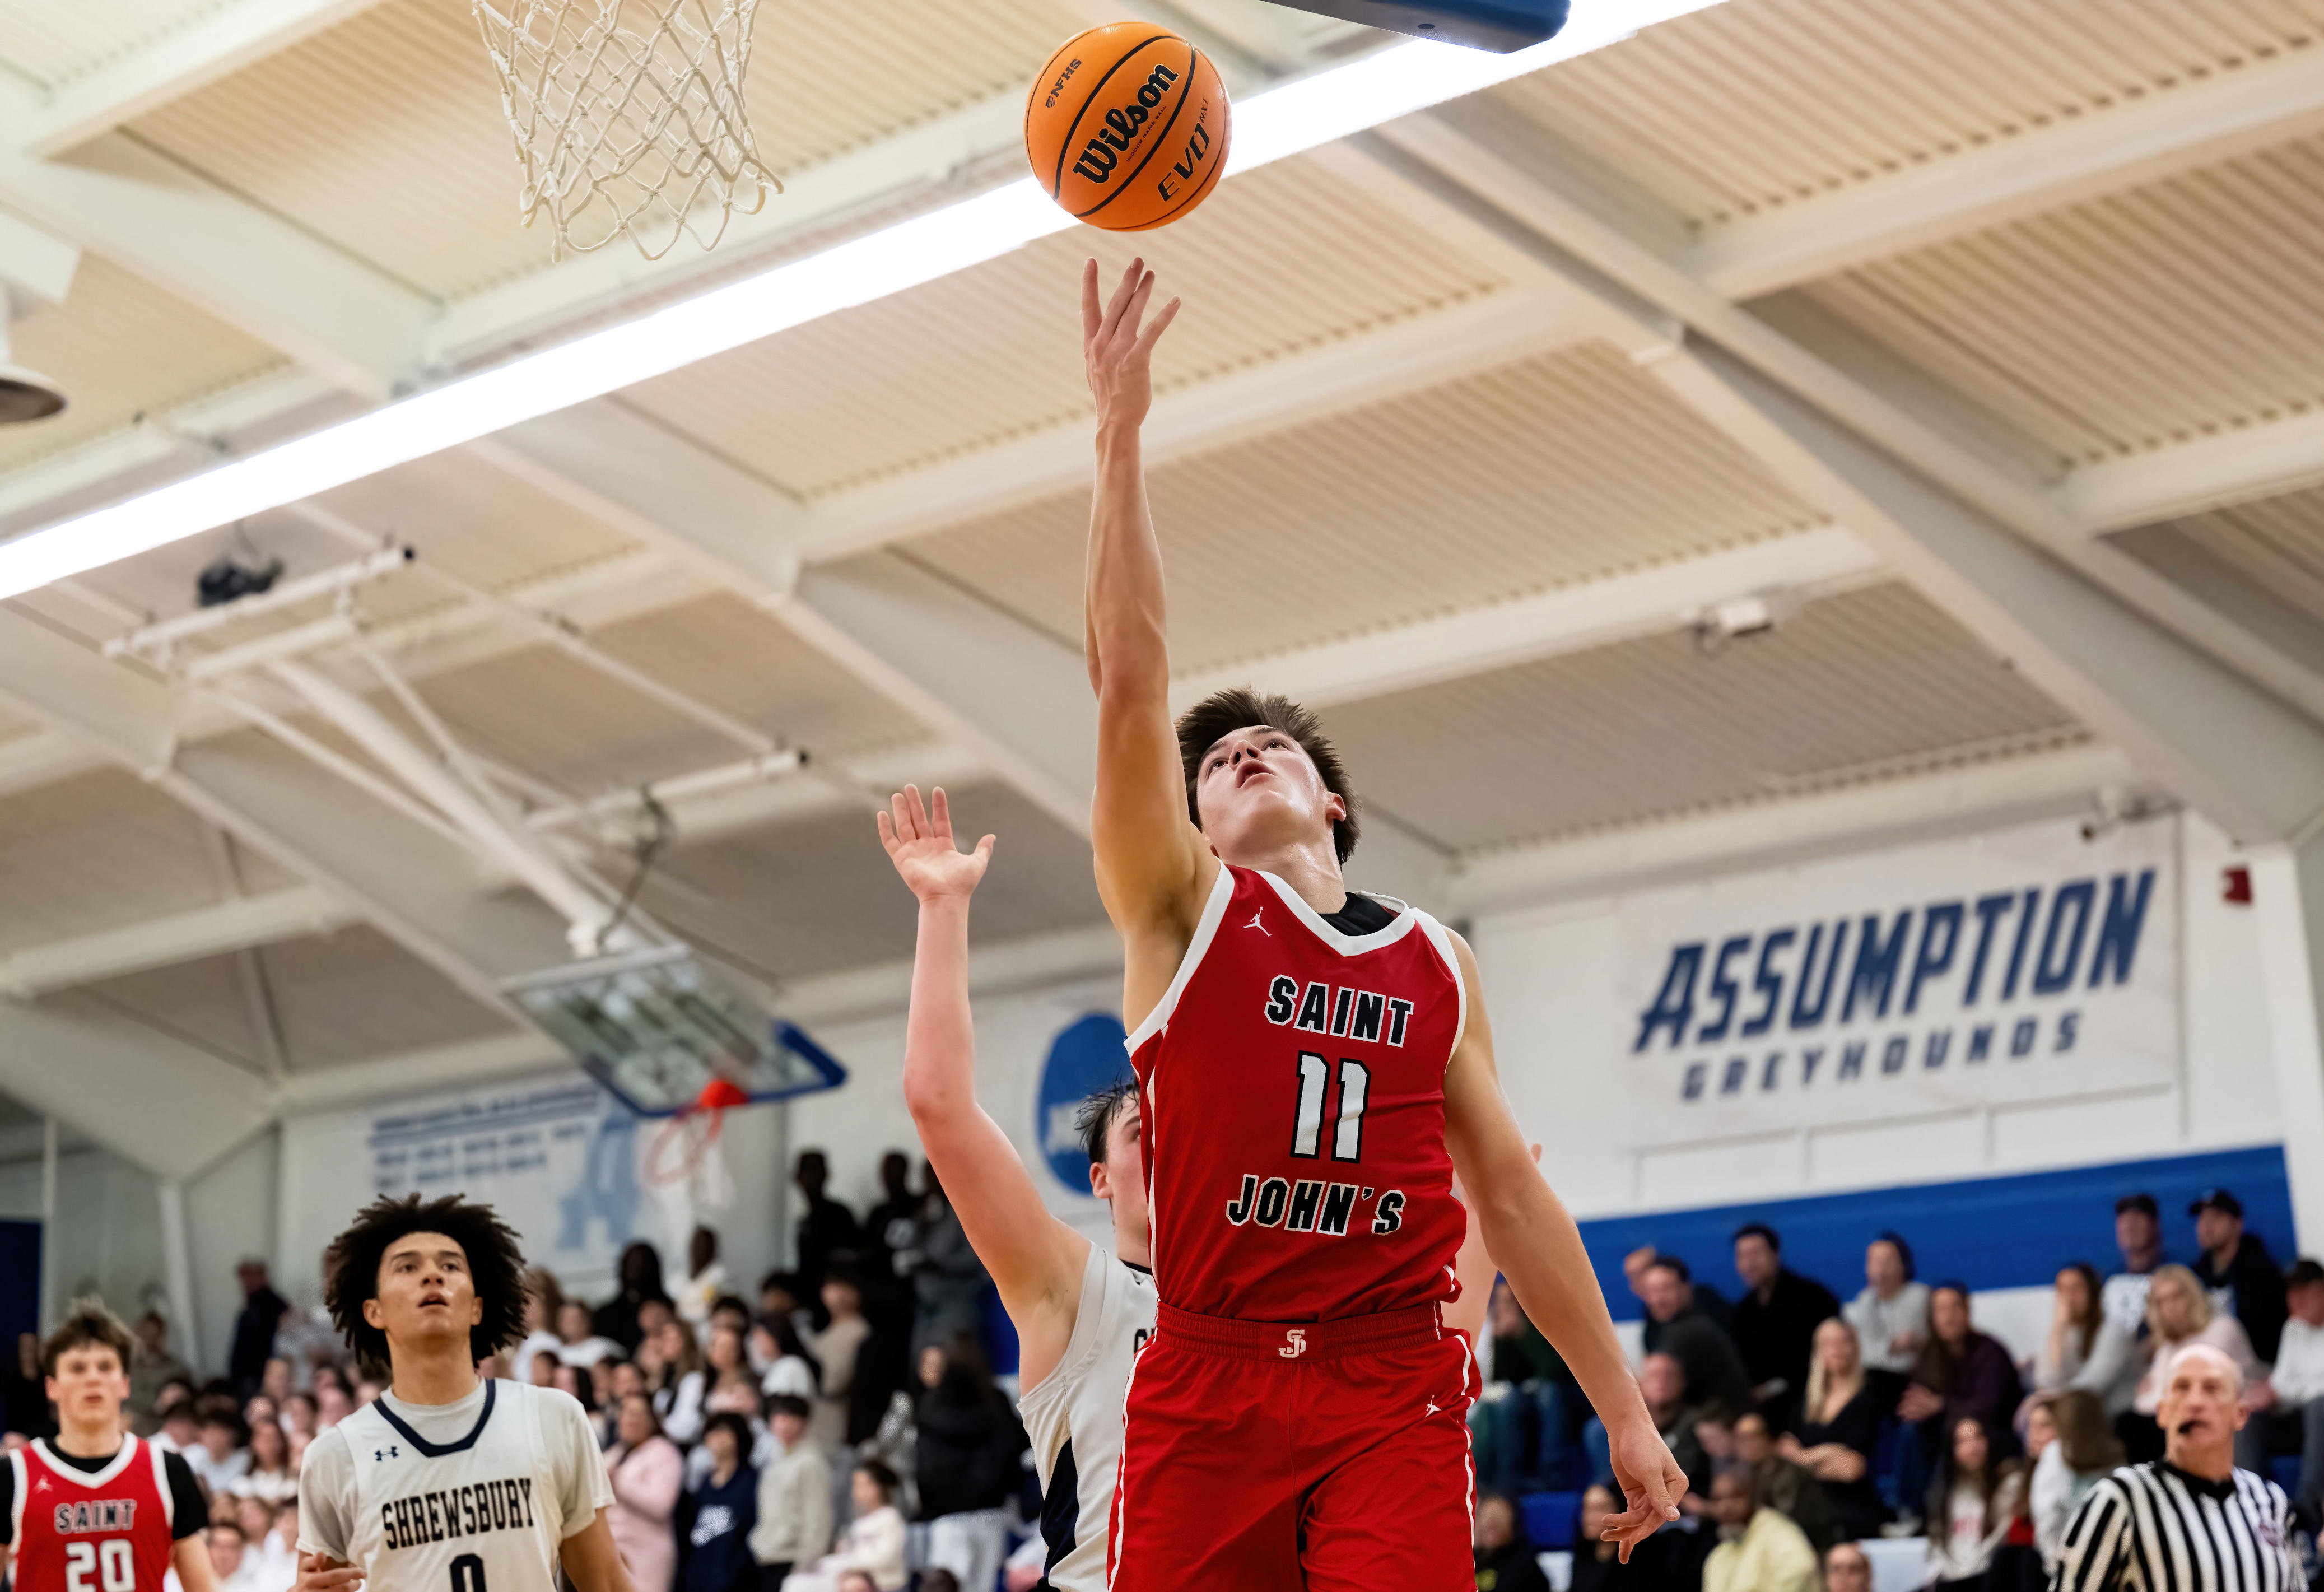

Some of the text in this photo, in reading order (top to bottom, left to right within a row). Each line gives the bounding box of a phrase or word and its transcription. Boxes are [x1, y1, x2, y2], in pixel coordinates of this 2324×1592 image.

[1051, 59, 1082, 97] NFHS
[1072, 64, 1180, 184] Wilson
[1143, 121, 1155, 138] GAME
[1155, 106, 1166, 119] BALL
[1631, 867, 2157, 1053] ASSUMPTION
[1264, 974, 1414, 1048] SAINT
[1680, 1009, 2083, 1101] GREYHOUNDS
[1289, 1050, 1371, 1163] 11
[1226, 1174, 1406, 1236] JOHN'S
[54, 1498, 137, 1535] SAINT
[382, 1478, 534, 1550] SHREWSBURY
[65, 1539, 136, 1592] 20
